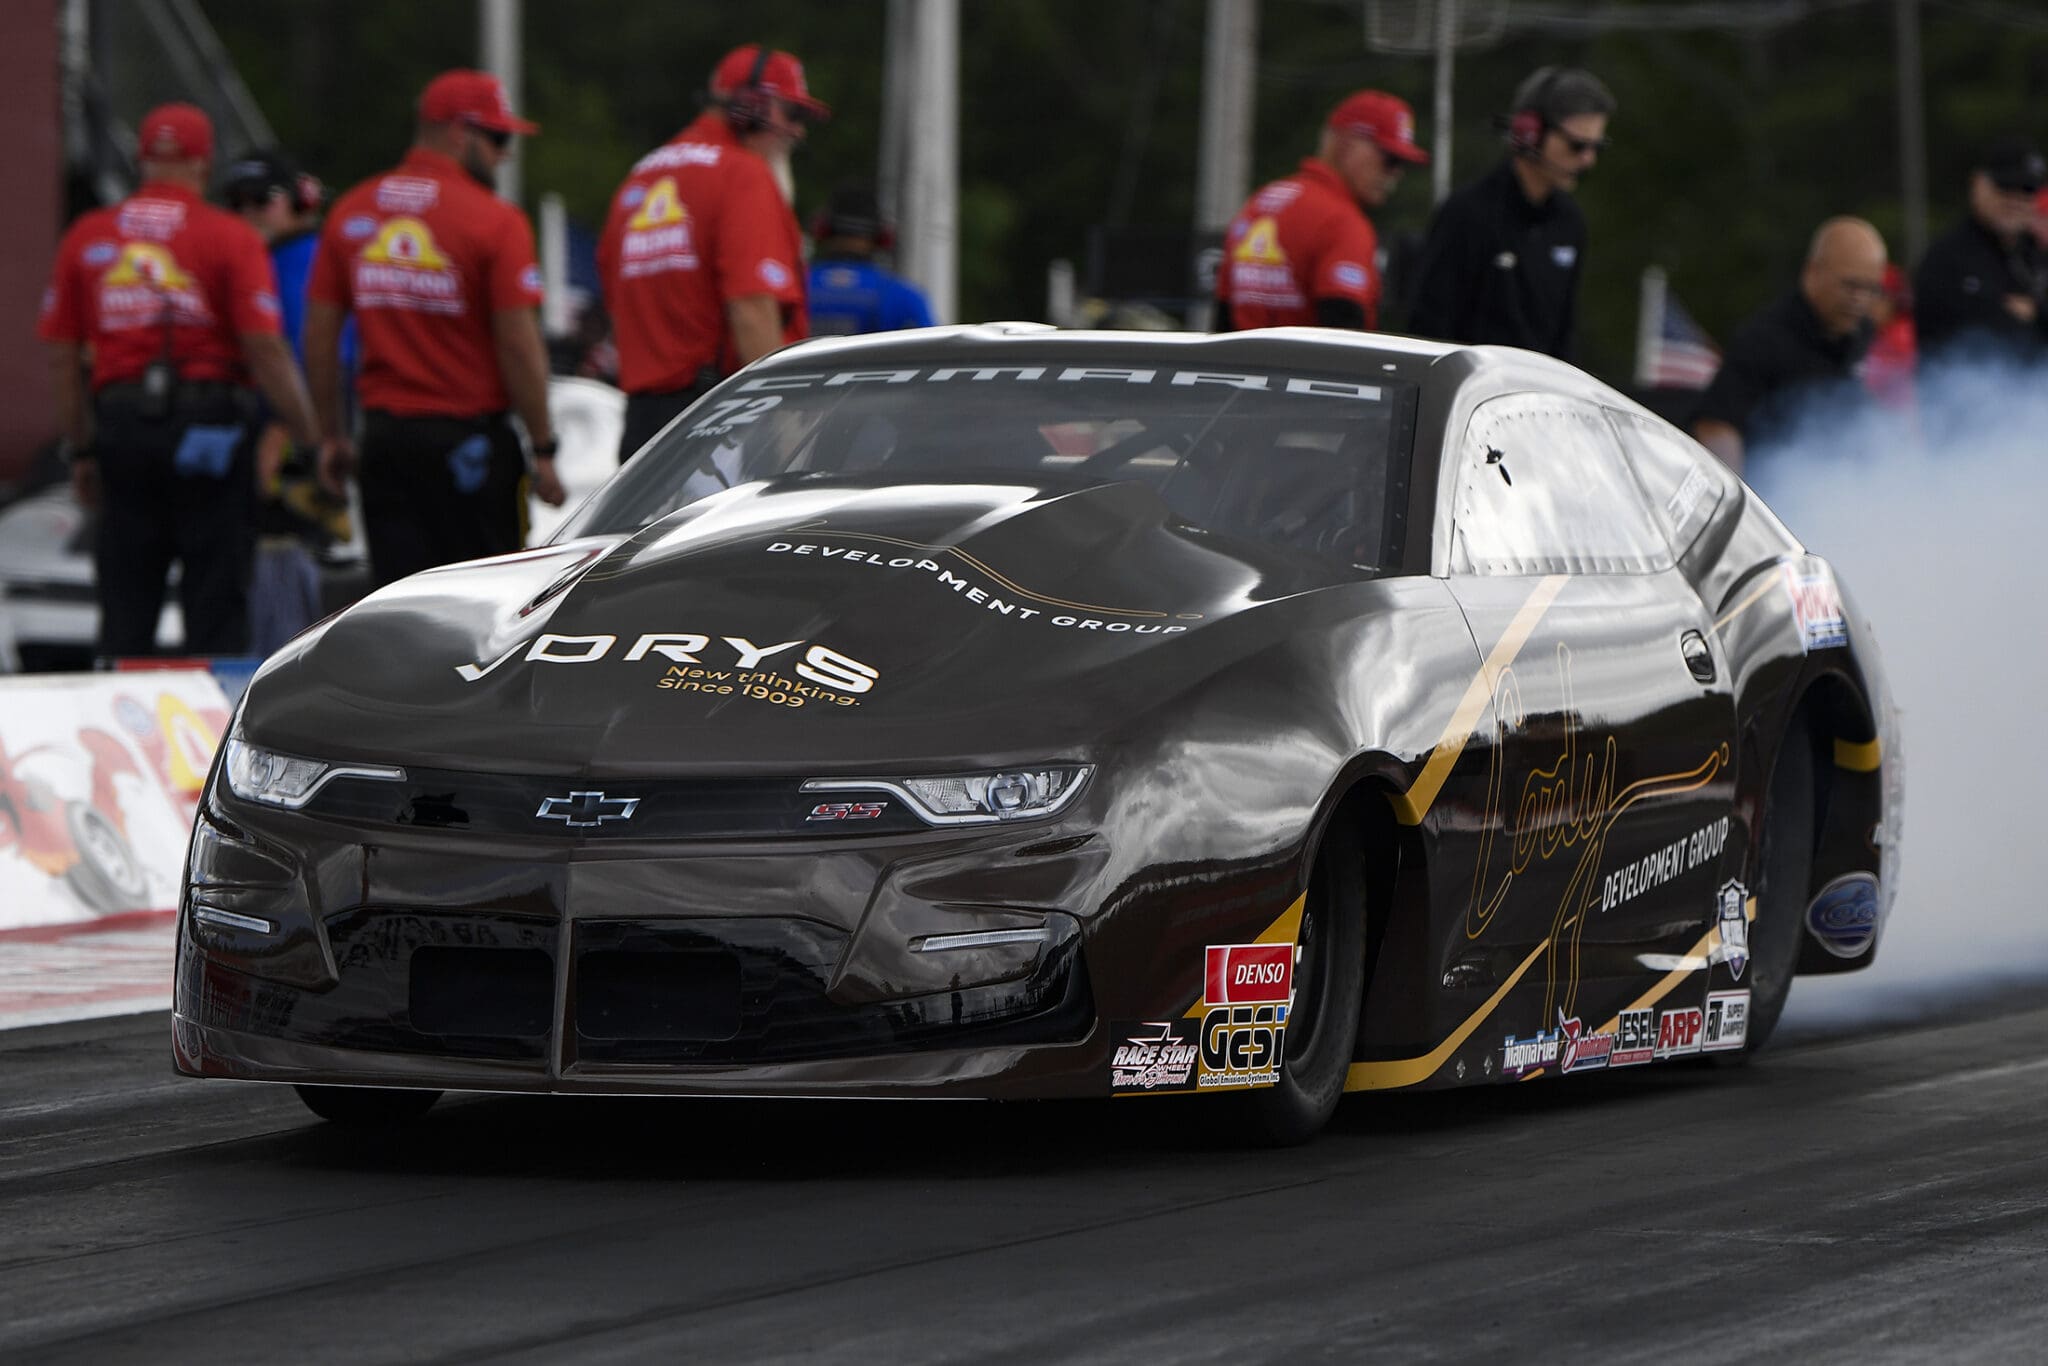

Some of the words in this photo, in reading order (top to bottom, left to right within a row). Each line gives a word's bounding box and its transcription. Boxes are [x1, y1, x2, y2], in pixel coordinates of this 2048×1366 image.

[734, 366, 1382, 401] CAMARO
[692, 395, 783, 430] 72
[766, 541, 1041, 621] DEVELOPMENT
[1051, 616, 1188, 636] GROUP
[656, 678, 734, 696] Since
[742, 683, 805, 708] 1909
[665, 665, 731, 681] New
[738, 671, 862, 707] thinking.
[805, 802, 889, 821] SS
[1602, 837, 1688, 913] DEVELOPMENT
[1688, 816, 1729, 869] GROUP
[1234, 962, 1285, 985] DENSO
[1613, 1010, 1655, 1051] JESEL
[1658, 1011, 1702, 1050] ARP
[1112, 1046, 1159, 1066] RACE
[1157, 1045, 1198, 1064] STAR
[1199, 1072, 1219, 1086] Global
[1220, 1072, 1247, 1085] Emissions
[1247, 1071, 1270, 1087] Systems
